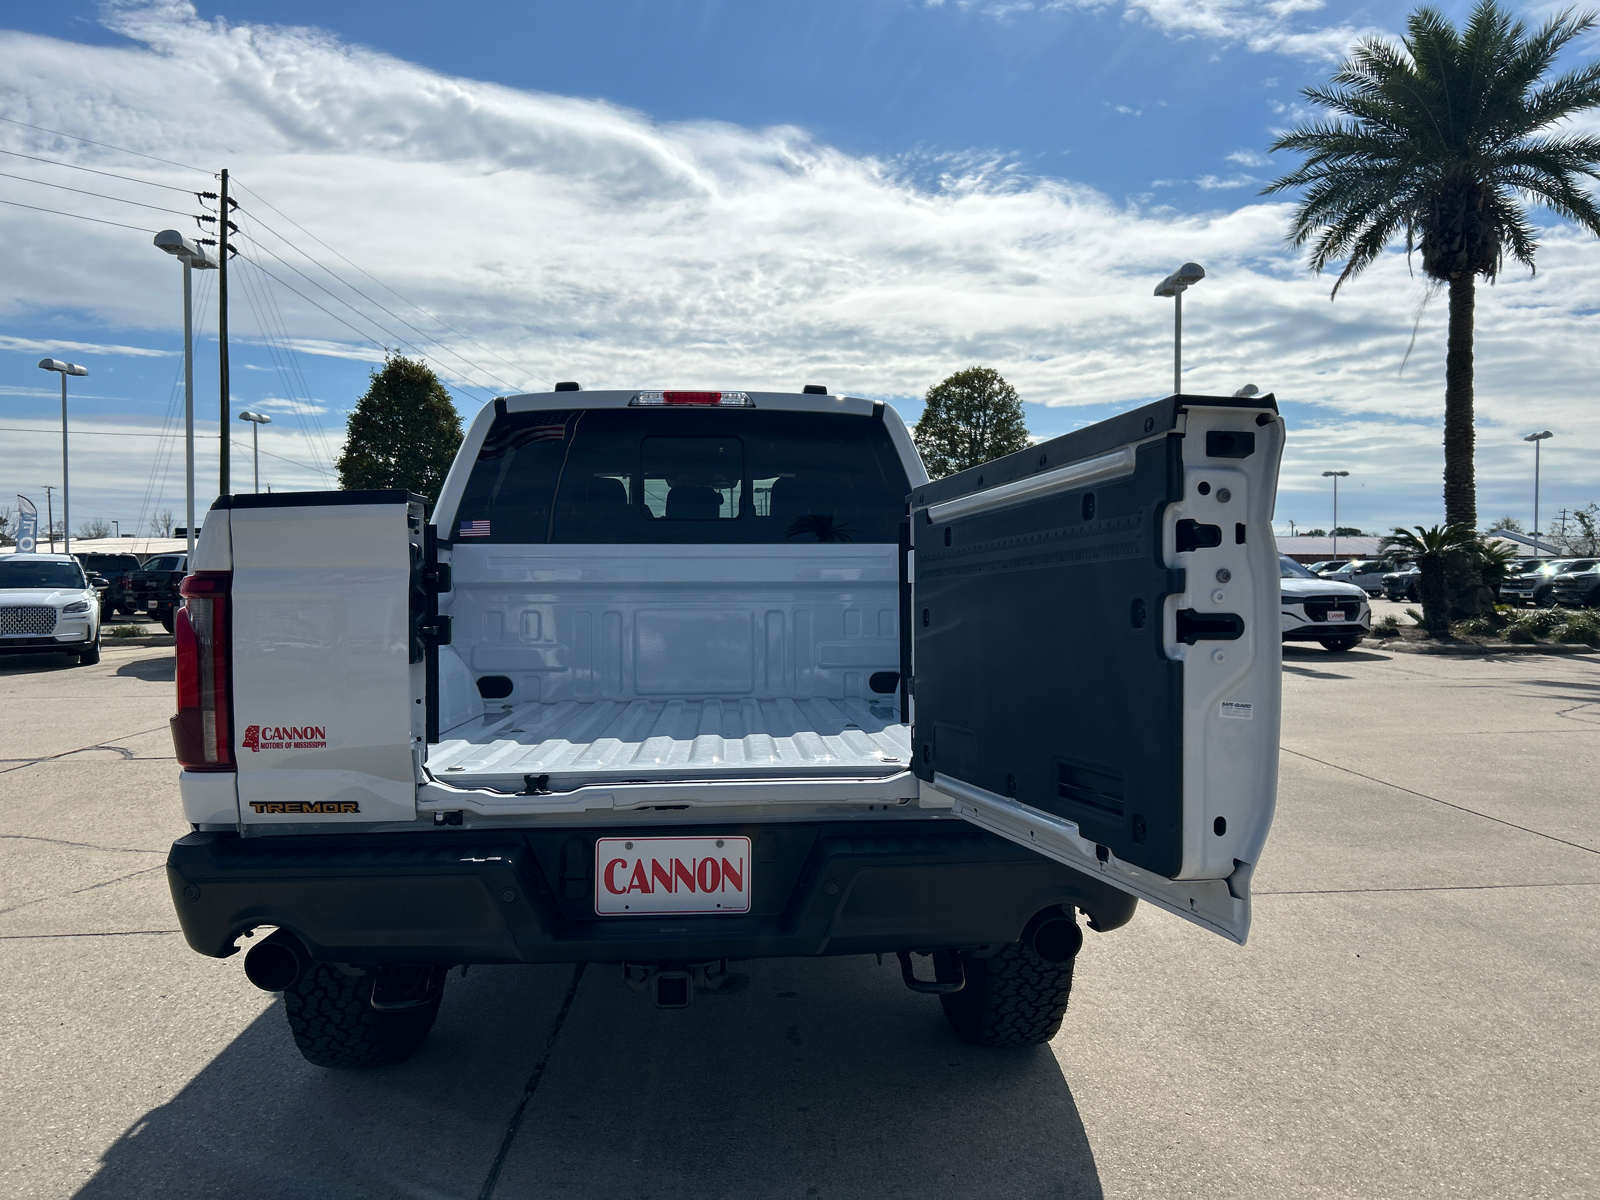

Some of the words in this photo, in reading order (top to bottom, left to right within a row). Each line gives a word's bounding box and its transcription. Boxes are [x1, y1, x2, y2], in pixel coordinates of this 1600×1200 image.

[261, 726, 326, 740] CANNON
[260, 742, 284, 750] MOTORS
[293, 741, 327, 749] MISSISSIPPI
[249, 800, 361, 814] TREMOR
[603, 857, 744, 895] CANNON
